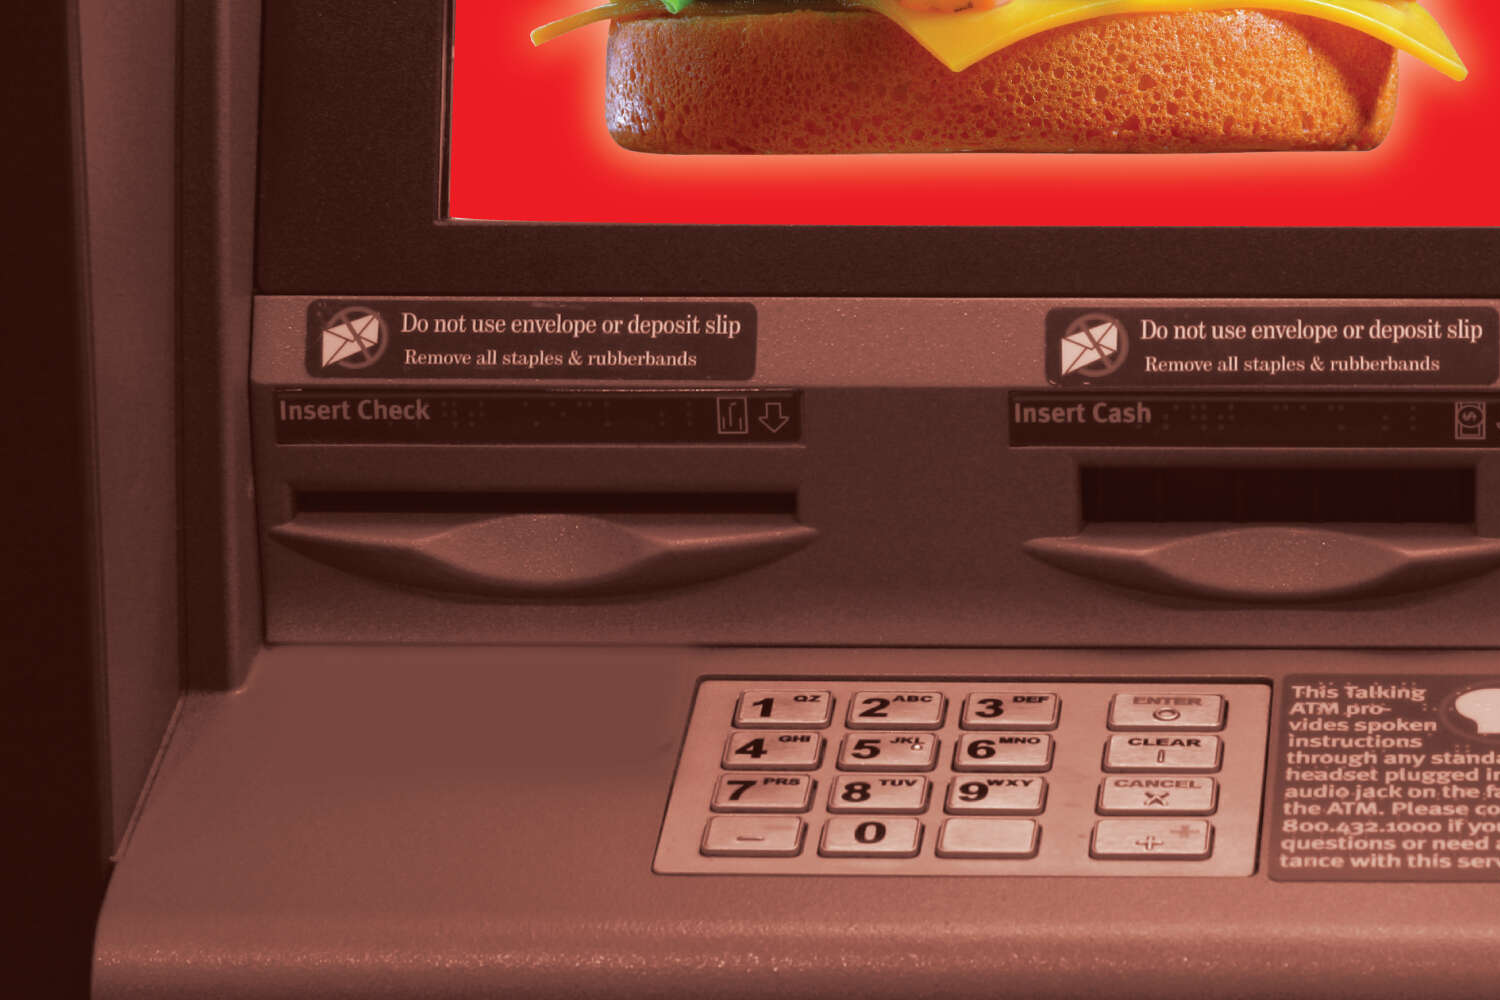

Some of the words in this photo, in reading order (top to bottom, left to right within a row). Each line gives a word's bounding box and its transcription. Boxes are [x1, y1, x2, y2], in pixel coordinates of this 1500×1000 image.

[401, 313, 428, 334] Do
[431, 315, 466, 334] not
[470, 318, 506, 334] use
[511, 314, 597, 339] envelope
[601, 319, 624, 335] or
[627, 315, 700, 339] deposit
[705, 315, 741, 339] slip
[1140, 319, 1167, 340] Do
[1170, 321, 1206, 340] not
[1210, 324, 1246, 341] use
[1251, 320, 1338, 344] envelope
[1343, 325, 1365, 341] or
[1368, 321, 1442, 344] deposit
[1446, 321, 1483, 344] slip
[403, 350, 472, 367] Remove
[476, 349, 498, 367] all
[502, 350, 563, 370] staples
[568, 351, 583, 367] &
[587, 350, 697, 367] rubberbands
[1145, 356, 1213, 373] Remove
[1217, 355, 1239, 373] all
[1243, 356, 1305, 375] staples
[1310, 357, 1325, 373] &
[1329, 355, 1440, 373] rubberbands
[280, 400, 351, 421] Insert
[357, 399, 431, 421] Check
[1014, 403, 1088, 424] Insert
[1092, 402, 1152, 424] Cash
[1133, 696, 1202, 705] ENTER
[1291, 685, 1339, 699] This
[1344, 685, 1427, 702] Talking
[752, 697, 775, 718] 1
[859, 697, 890, 717] 2
[975, 698, 1004, 718] 3
[1013, 695, 1050, 703] DEF
[1289, 702, 1339, 715] ATM
[1346, 704, 1392, 718] pro-
[1288, 718, 1349, 732] vides
[1354, 718, 1437, 734] spoken
[735, 738, 767, 759] 4
[851, 739, 881, 759] 5
[967, 739, 996, 759] 6
[999, 737, 1041, 745] MNO
[1128, 737, 1201, 747] CLEAR
[1287, 734, 1423, 748] instructions
[1286, 751, 1377, 768] through
[1383, 754, 1426, 768] any
[1113, 779, 1202, 788] CANCEL
[1285, 767, 1378, 782] headset
[1384, 767, 1479, 785] plugged
[727, 780, 757, 800] 7
[763, 777, 800, 785] PRS
[841, 782, 871, 802] 8
[958, 782, 989, 801] 9
[987, 779, 1034, 787] WXY
[1284, 784, 1349, 798] audio
[1355, 784, 1402, 801] jack
[1407, 787, 1436, 798] on
[1442, 784, 1480, 798] the
[1283, 801, 1321, 815] the
[1326, 801, 1385, 815] ATM.
[1391, 801, 1469, 816] Please
[854, 822, 887, 844] 0
[1281, 819, 1442, 835] 800.432.1000
[1448, 818, 1464, 833] if
[1280, 836, 1397, 853] questions
[1402, 839, 1427, 850] or
[1432, 836, 1489, 850] need
[1279, 854, 1345, 868] tance
[1350, 854, 1400, 868] with
[1407, 854, 1452, 868] this
